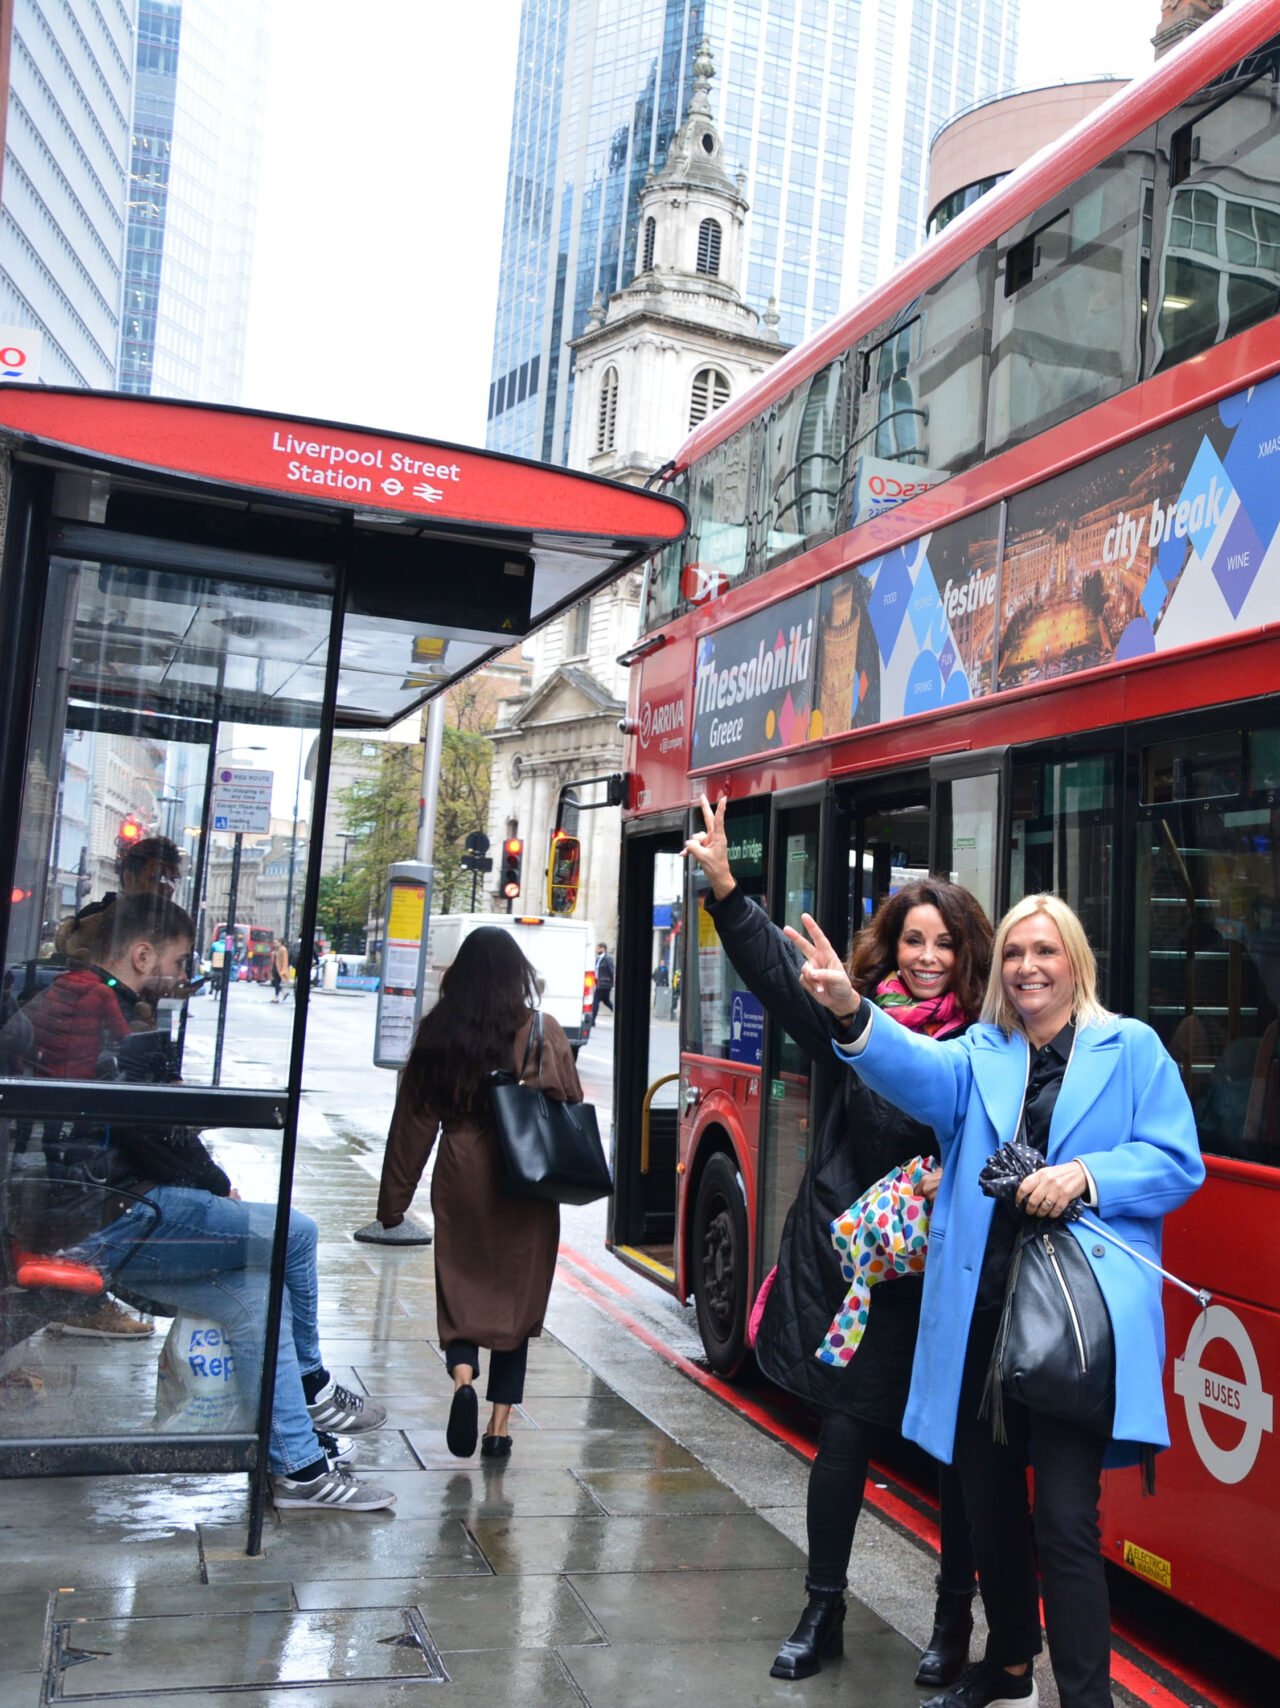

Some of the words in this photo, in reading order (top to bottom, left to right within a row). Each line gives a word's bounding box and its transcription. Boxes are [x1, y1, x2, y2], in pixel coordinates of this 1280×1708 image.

[272, 432, 384, 469] Liverpool
[389, 453, 461, 482] Street
[287, 461, 372, 493] Station
[940, 567, 997, 633] festive
[1102, 512, 1146, 569] city
[1148, 475, 1225, 548] break
[1227, 552, 1250, 572] WINE
[883, 591, 897, 606] FOOD
[697, 618, 813, 715] Thessaloniki
[941, 654, 953, 668] FUN
[651, 699, 684, 737] ARRIVA
[709, 717, 744, 748] Greece
[743, 838, 763, 864] Bridge
[1204, 1378, 1241, 1411] BUSES
[1133, 1547, 1169, 1577] ELECTRICAL
[1135, 1559, 1168, 1585] WARNING
